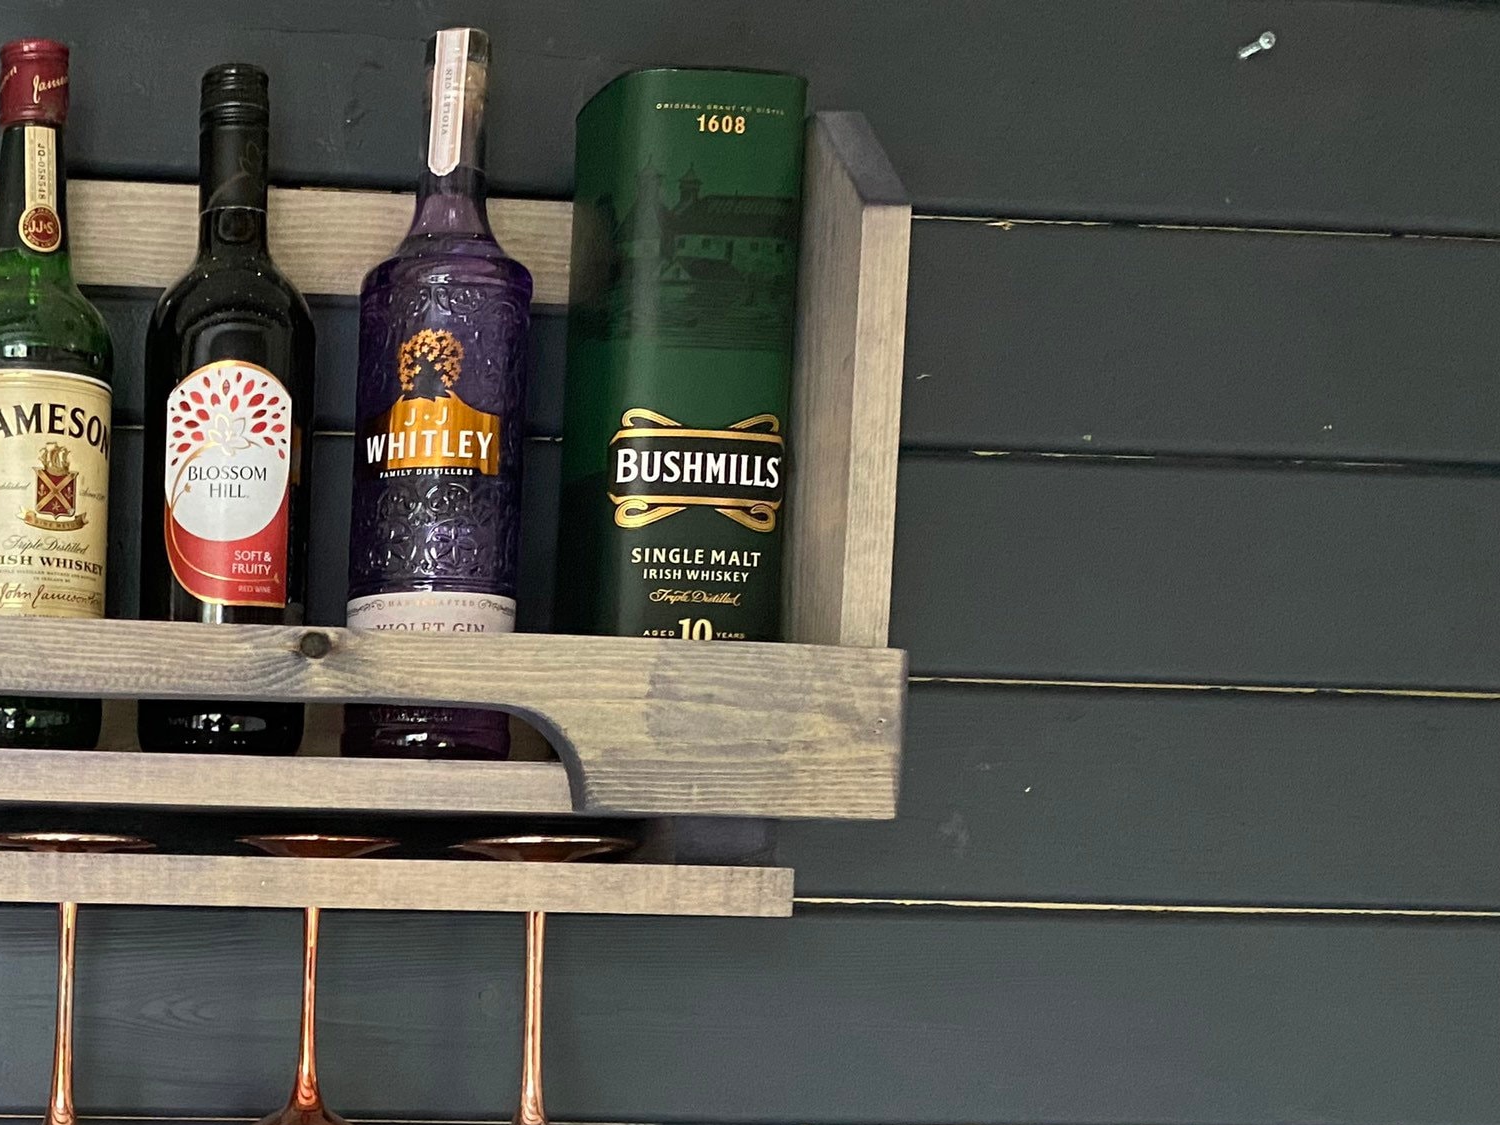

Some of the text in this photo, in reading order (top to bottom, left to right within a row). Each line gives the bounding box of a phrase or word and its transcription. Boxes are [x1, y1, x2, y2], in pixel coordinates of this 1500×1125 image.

[696, 113, 746, 134] 1608
[366, 429, 493, 464] WHITLEY
[188, 466, 267, 481] BLOSSOM
[379, 468, 473, 479] FAMILY DISTILLERS
[616, 448, 780, 489] BUSHMILLS
[209, 483, 246, 498] HILL
[234, 550, 261, 562] SOFT
[631, 547, 761, 567] SINGLE MALT
[39, 556, 103, 576] WHISKEY
[231, 563, 271, 575] FRUITY
[643, 568, 749, 583] IRISH WHISKEY
[255, 585, 271, 593] WINE
[678, 618, 713, 641] 10
